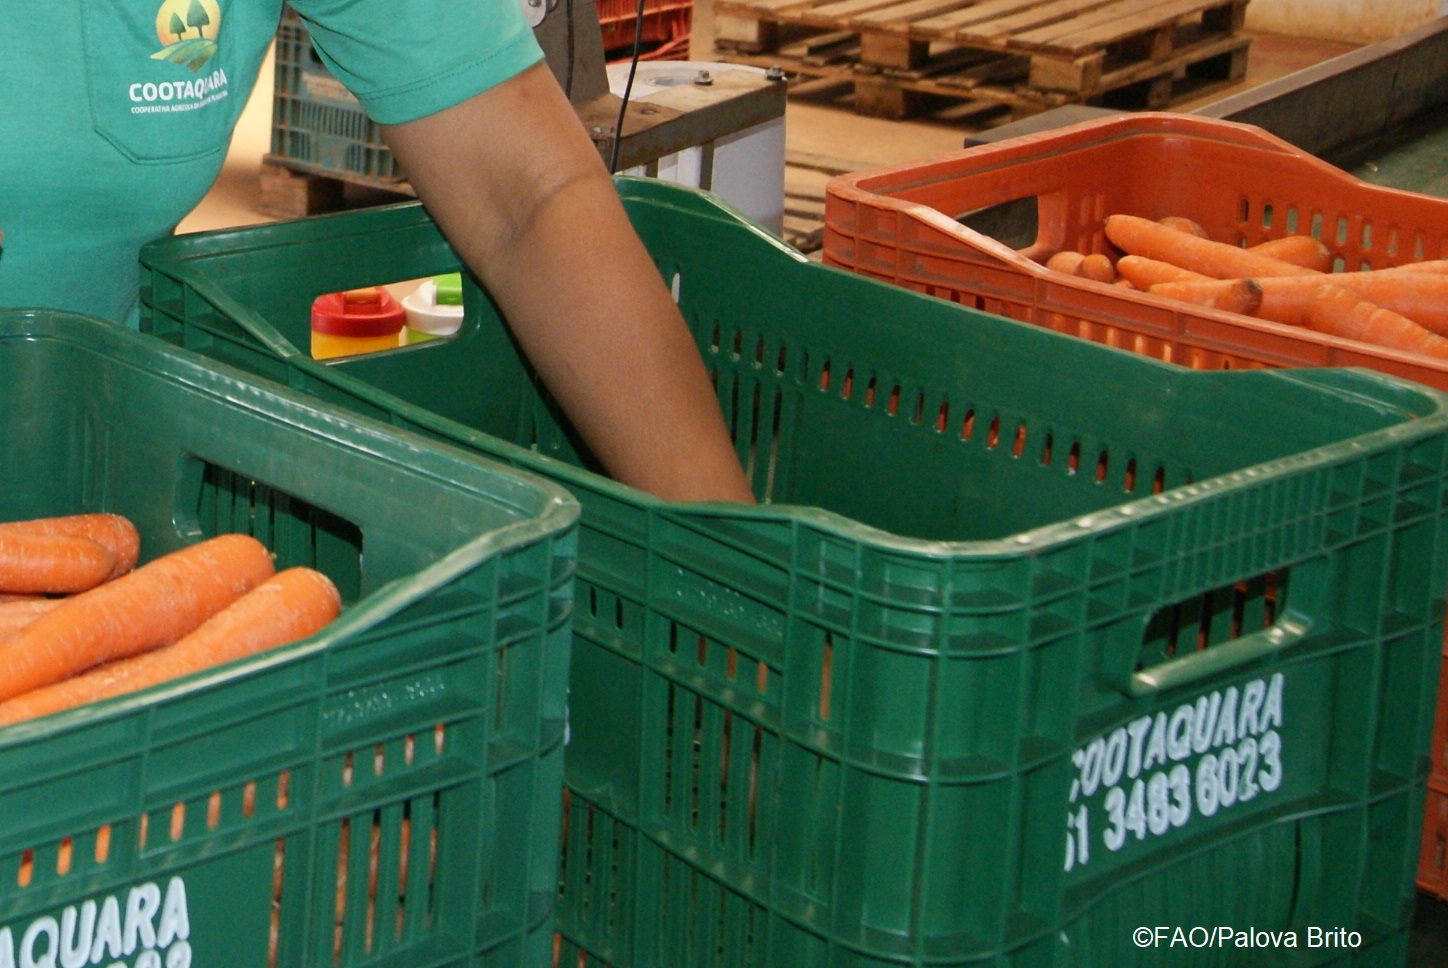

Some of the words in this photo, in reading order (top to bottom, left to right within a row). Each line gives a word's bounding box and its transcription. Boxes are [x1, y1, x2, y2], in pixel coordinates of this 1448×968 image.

[129, 68, 228, 102] COOTAQUARA
[1103, 764, 1191, 852] 3483
[1196, 730, 1283, 816] 6023
